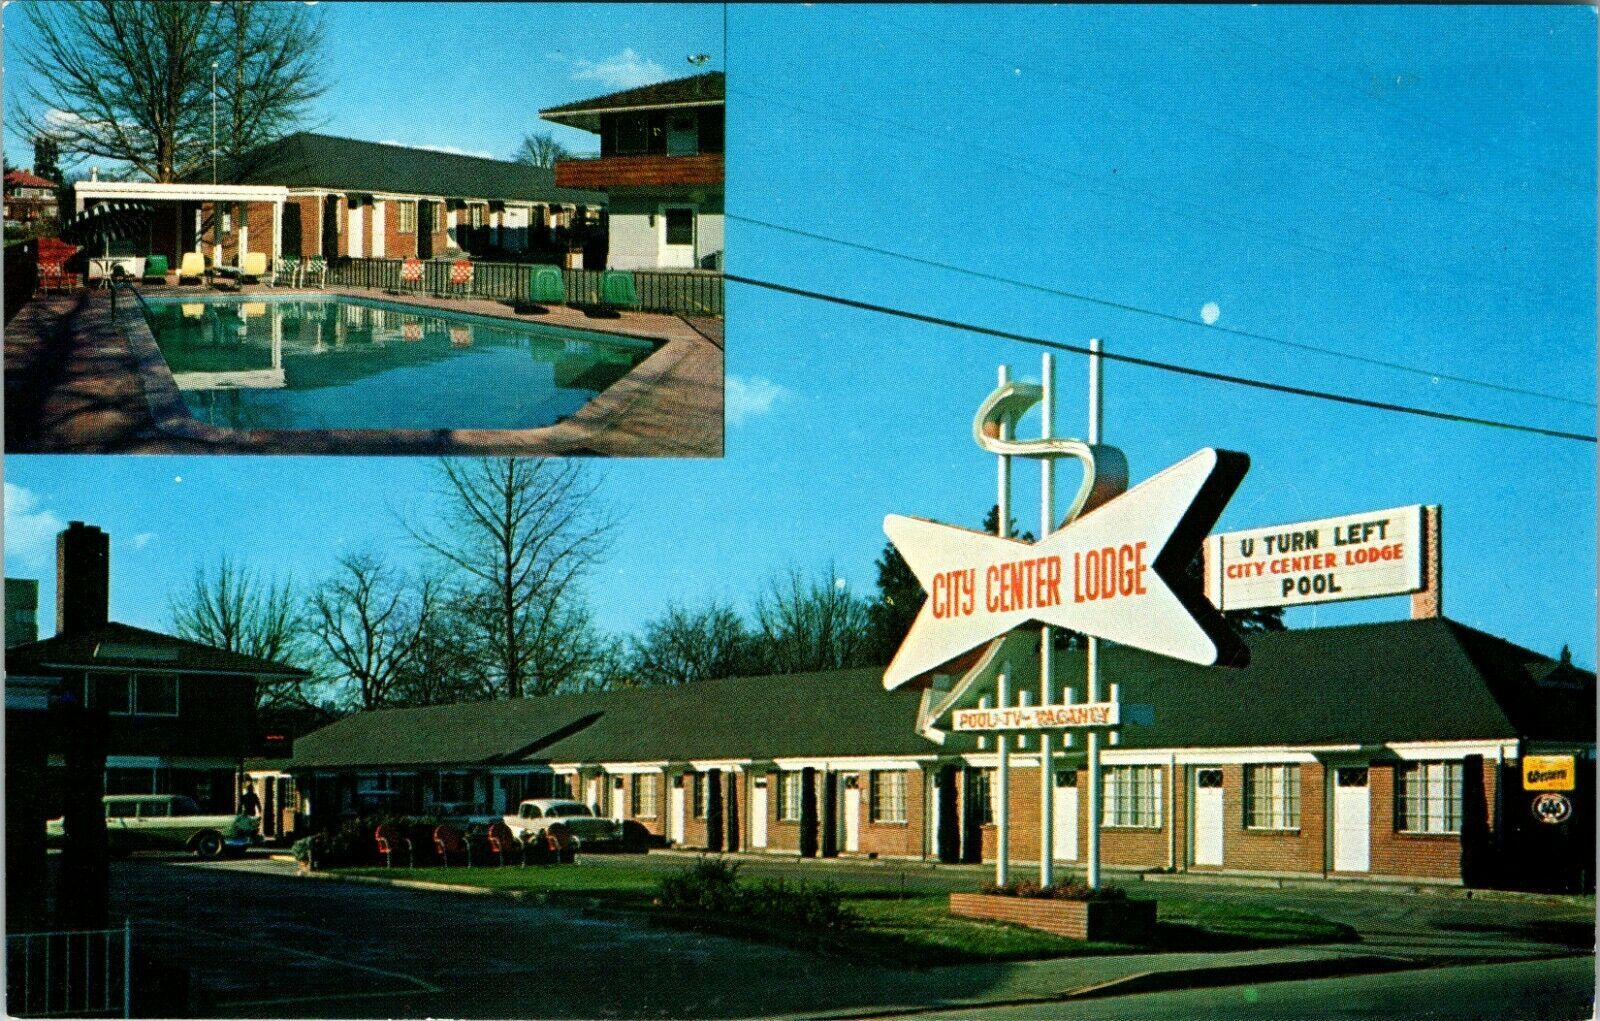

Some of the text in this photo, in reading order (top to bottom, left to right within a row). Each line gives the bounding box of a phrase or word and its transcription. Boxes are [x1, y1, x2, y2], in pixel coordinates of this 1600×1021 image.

[1240, 519, 1390, 557] U TURN LEFT
[1226, 543, 1404, 579] CITY CENTER LODGE
[932, 541, 1147, 619] CITY CENTER LODGE
[1282, 573, 1342, 597] POOL
